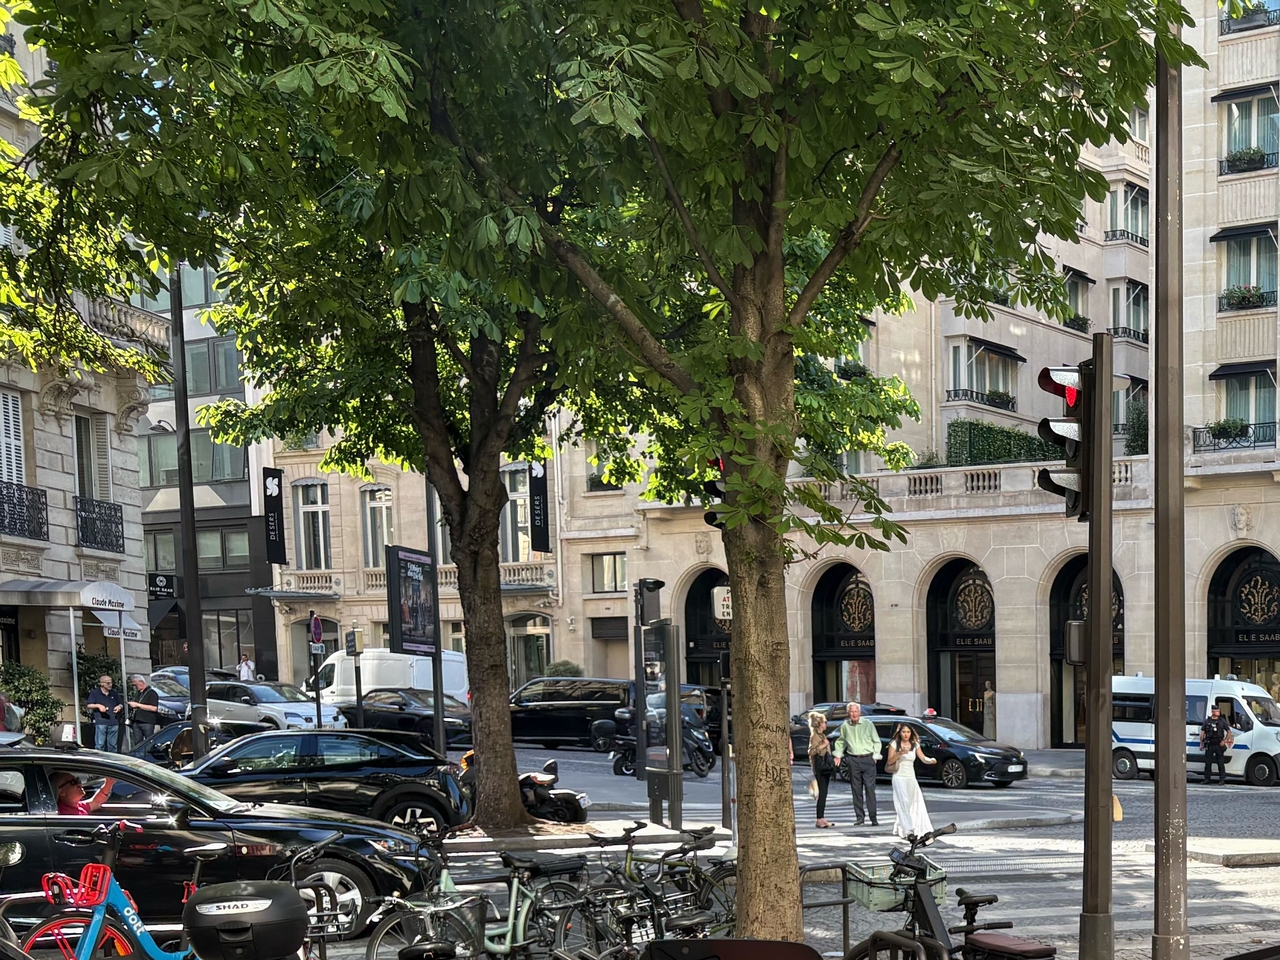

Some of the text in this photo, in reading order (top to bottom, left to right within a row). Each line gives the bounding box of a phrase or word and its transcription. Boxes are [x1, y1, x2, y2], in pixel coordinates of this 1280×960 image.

[91, 596, 125, 609] Claude Maxime
[956, 637, 972, 645] ELIE
[1259, 633, 1280, 641] SAAB
[840, 639, 856, 647] ELIE
[215, 903, 249, 911] SHAD
[123, 906, 147, 937] dott
